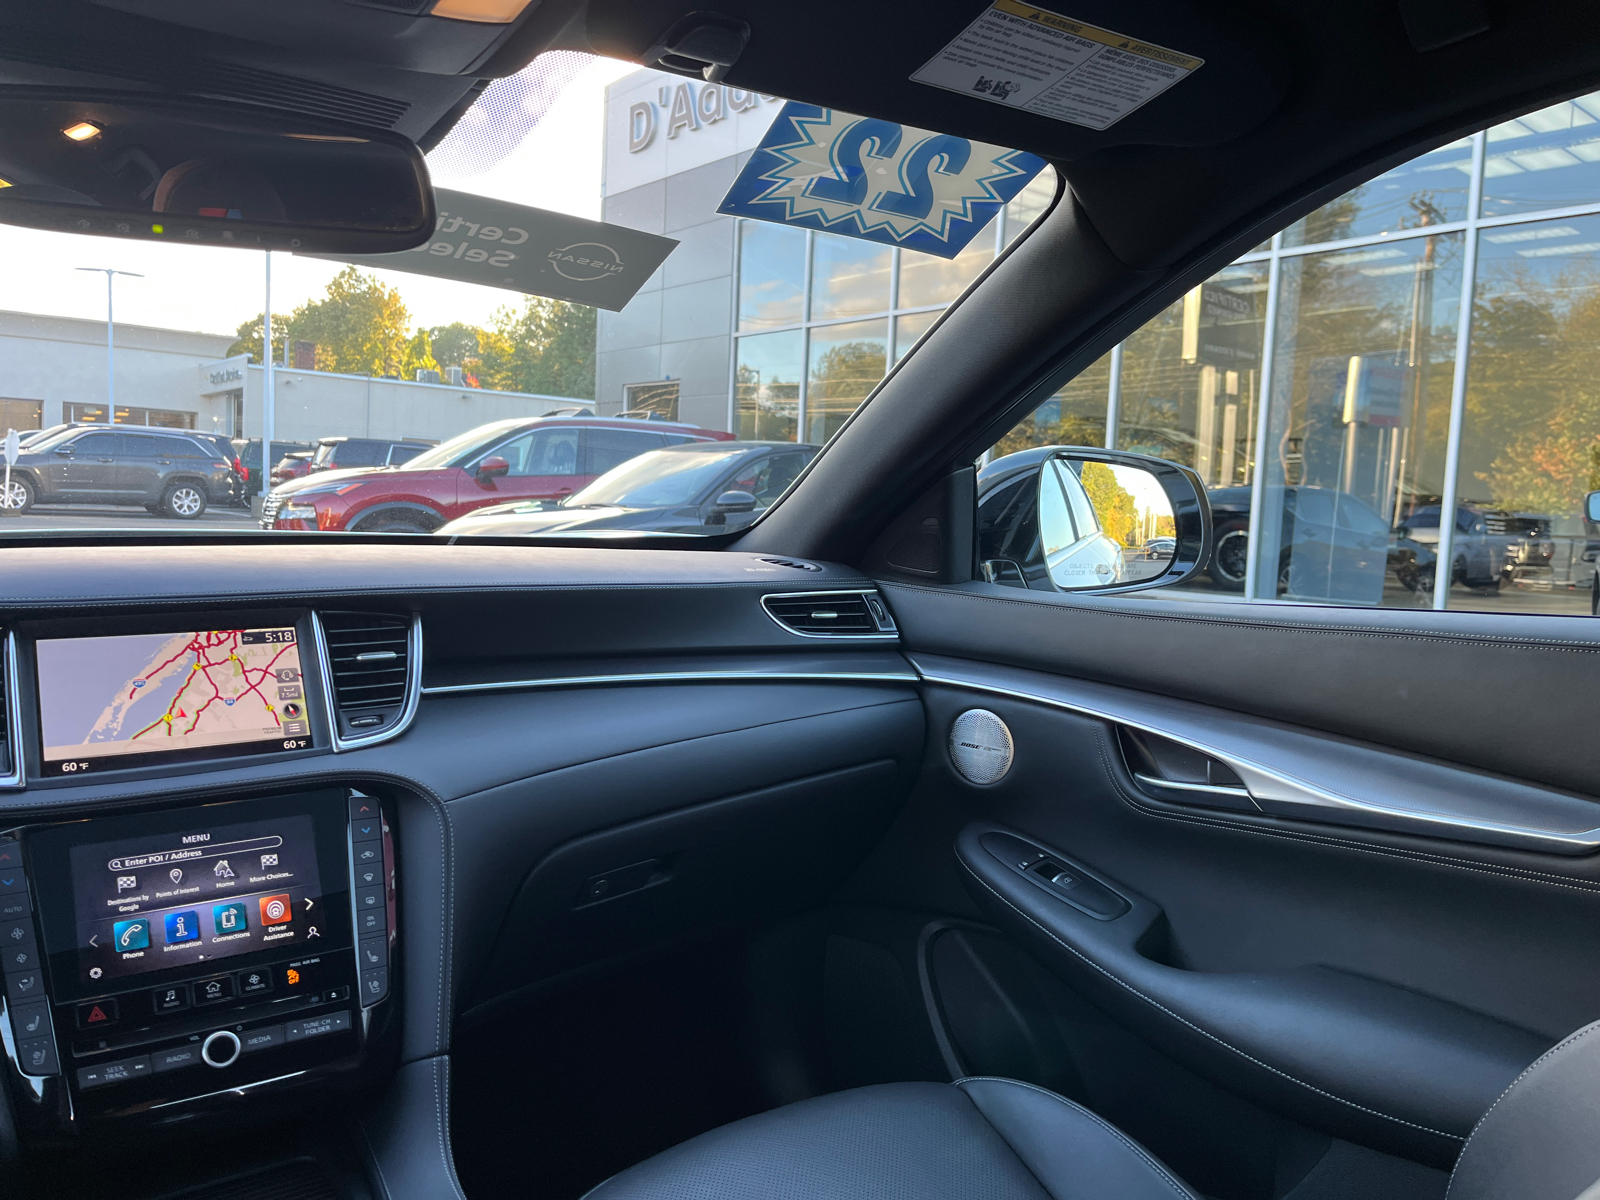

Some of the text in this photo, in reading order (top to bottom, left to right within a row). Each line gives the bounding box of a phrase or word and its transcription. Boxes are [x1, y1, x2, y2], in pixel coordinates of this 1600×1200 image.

[988, 11, 1009, 21] EVEN
[1008, 17, 1028, 27] WITH
[1027, 23, 1065, 38] ADVANCED
[1076, 39, 1097, 48] BAGS
[1042, 16, 1084, 33] WARNING
[1132, 44, 1191, 67] AVERTISSEMENT
[265, 631, 292, 642] 5:18
[283, 740, 297, 749] 60
[62, 762, 78, 772] 60
[182, 833, 211, 844] MENU
[124, 857, 147, 867] Enter
[149, 855, 163, 863] POI
[170, 850, 202, 860] Address
[155, 890, 172, 898] Points
[179, 886, 200, 894] Interest
[107, 895, 142, 906] Destinations
[119, 903, 140, 912] Google
[268, 924, 287, 933] Driver
[212, 931, 251, 943] Connections
[263, 931, 295, 942] Assistance
[163, 940, 203, 952] Information
[122, 951, 145, 960] Phone
[245, 983, 266, 991] CLIMATE
[305, 1025, 331, 1035] FOLDER
[247, 1034, 272, 1045] MEDIA
[166, 1052, 191, 1063] RADIO
[105, 1065, 124, 1074] SEEK
[104, 1071, 129, 1080] TRACK
